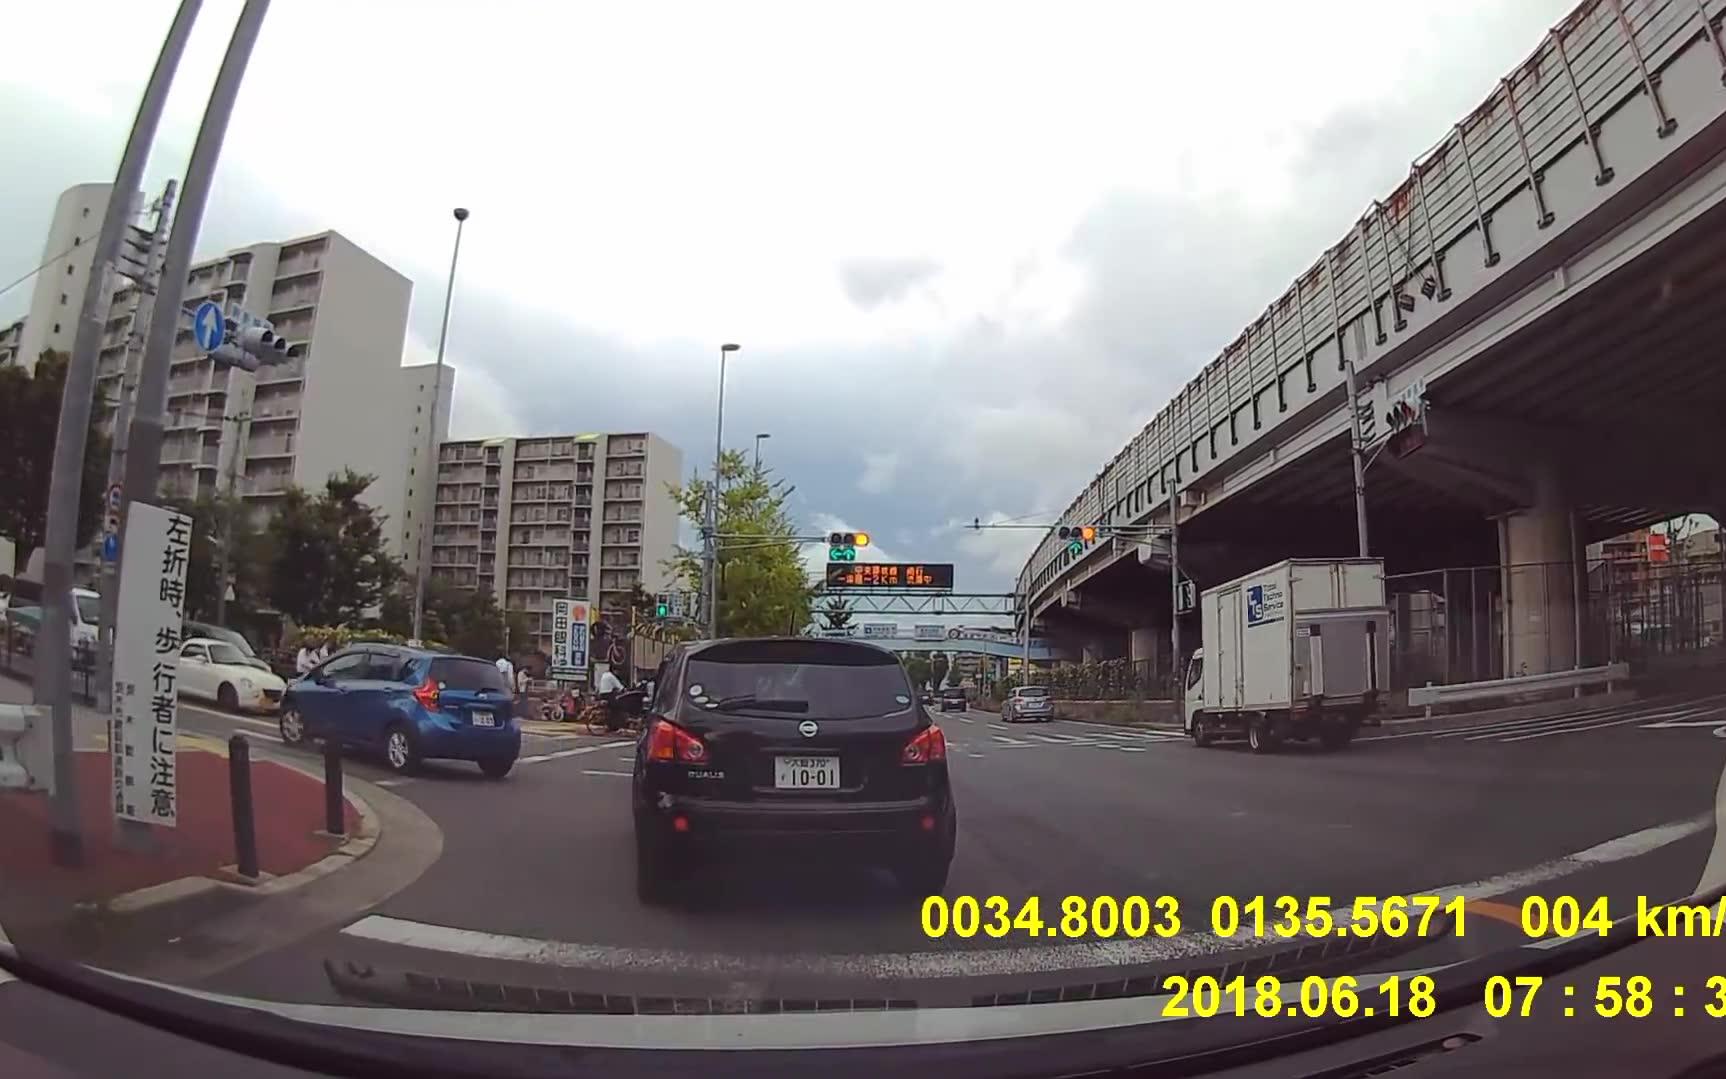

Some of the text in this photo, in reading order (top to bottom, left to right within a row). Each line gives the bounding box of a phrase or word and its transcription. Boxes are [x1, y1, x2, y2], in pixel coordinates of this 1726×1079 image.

[150, 516, 190, 817] 左折時、歩行者に注意
[792, 769, 834, 786] 10-01
